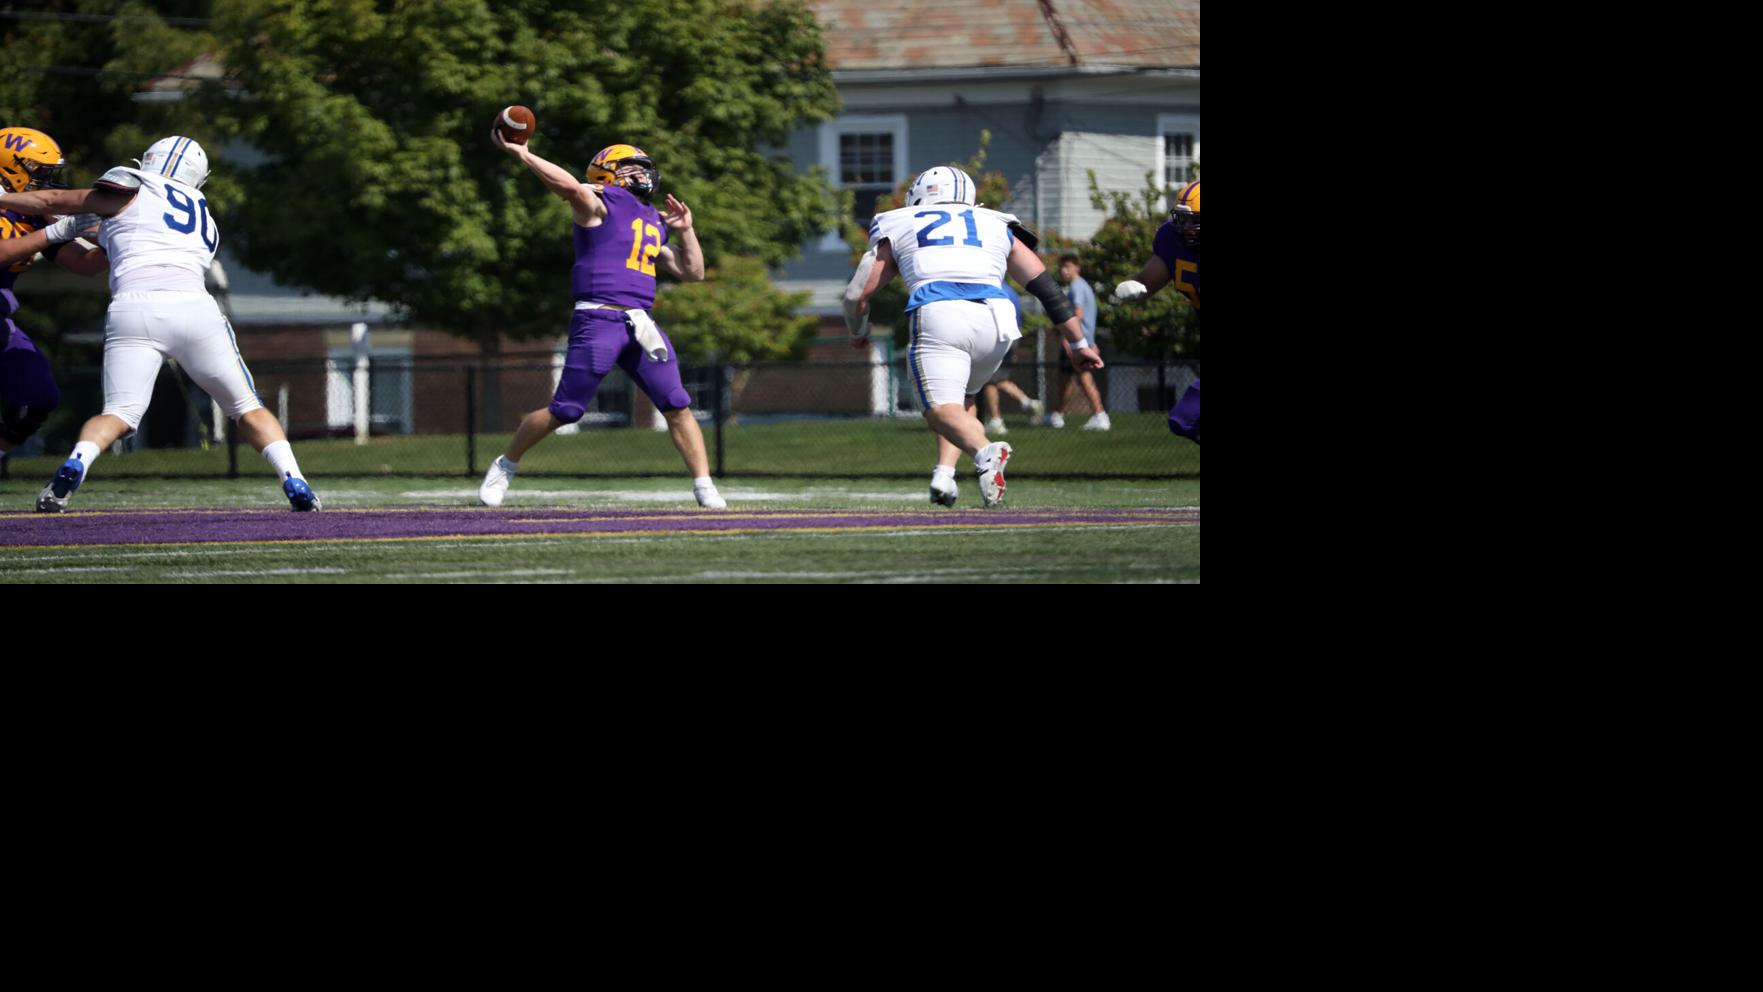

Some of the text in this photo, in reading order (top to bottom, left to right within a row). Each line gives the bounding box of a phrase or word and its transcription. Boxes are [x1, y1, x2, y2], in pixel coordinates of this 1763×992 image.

[5, 133, 32, 152] W
[163, 183, 218, 253] 90
[914, 209, 983, 248] 21
[626, 217, 661, 277] 12
